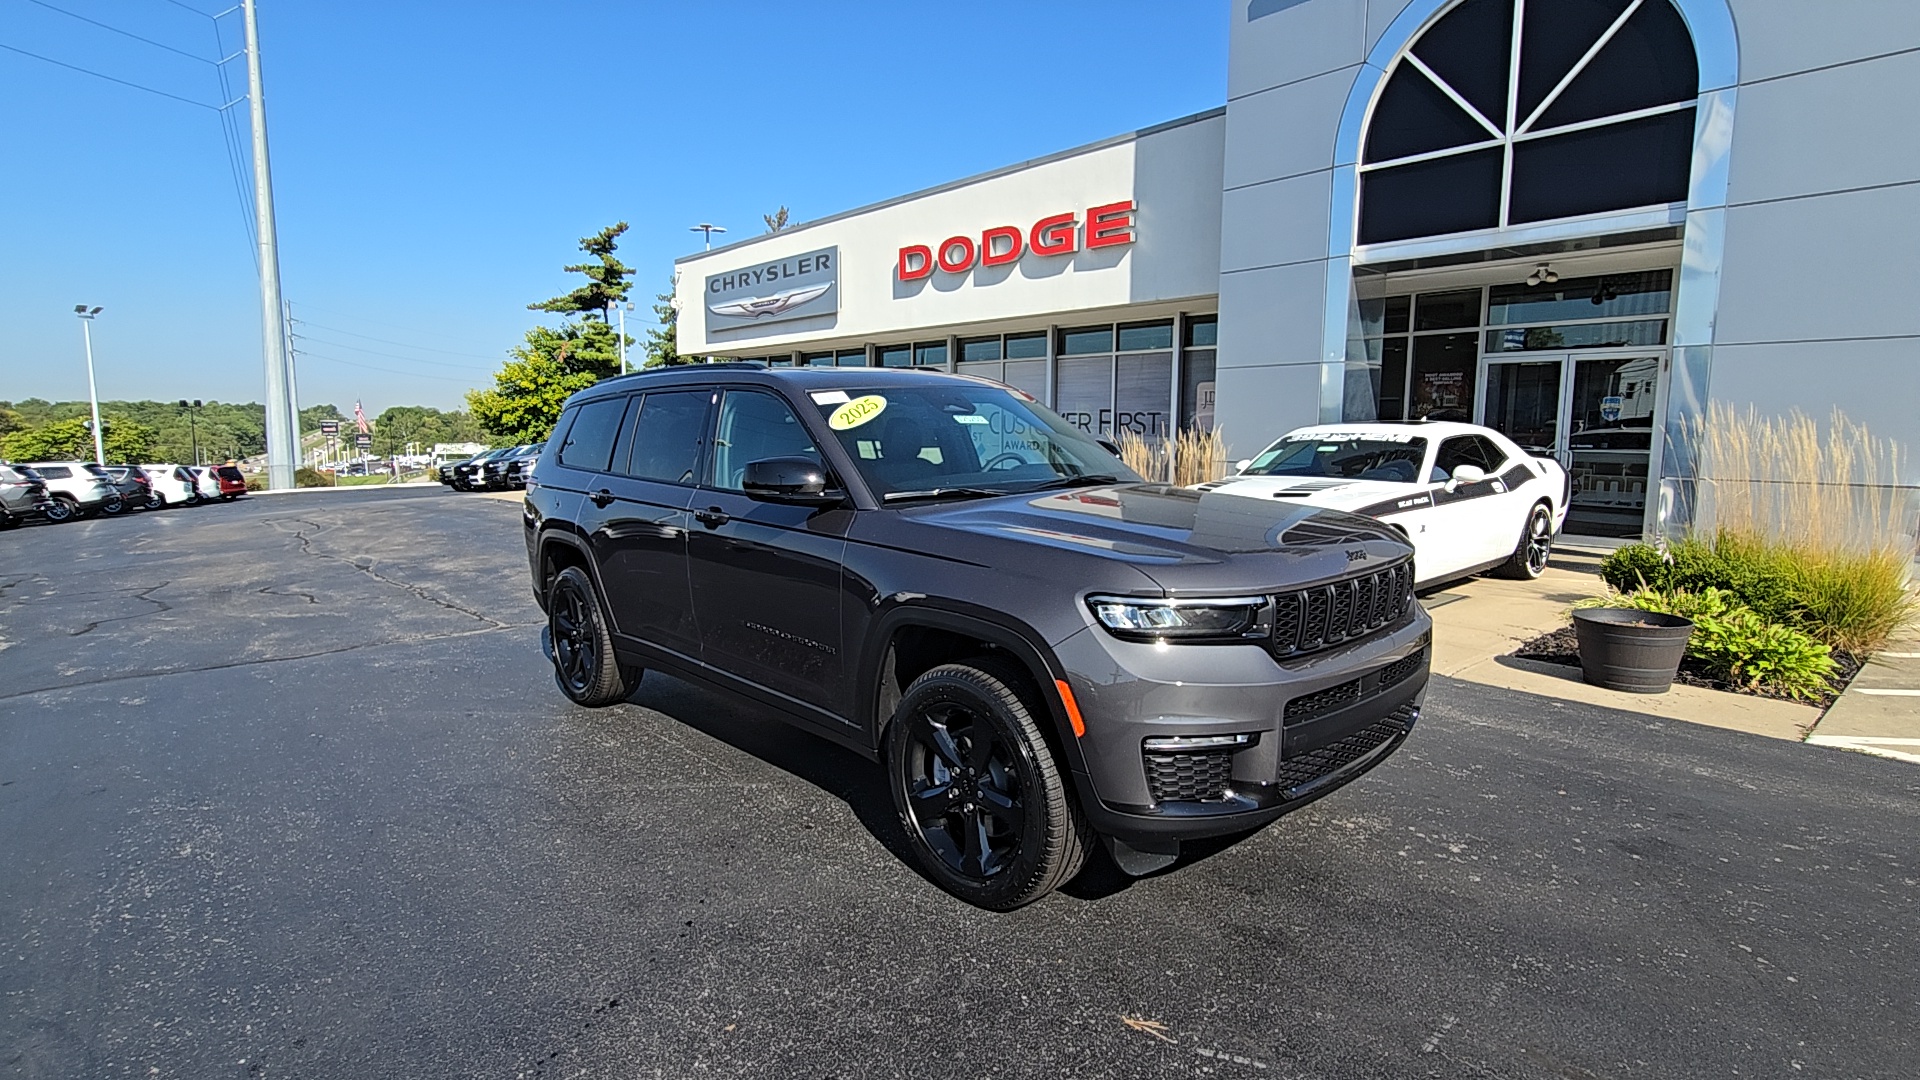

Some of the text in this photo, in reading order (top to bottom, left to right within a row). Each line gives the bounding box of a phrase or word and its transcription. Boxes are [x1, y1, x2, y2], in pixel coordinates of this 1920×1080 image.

[898, 199, 1137, 281] DODGE
[709, 253, 831, 294] CHRYSLER
[839, 398, 879, 425] 2025
[1004, 440, 1040, 451] AWARD
